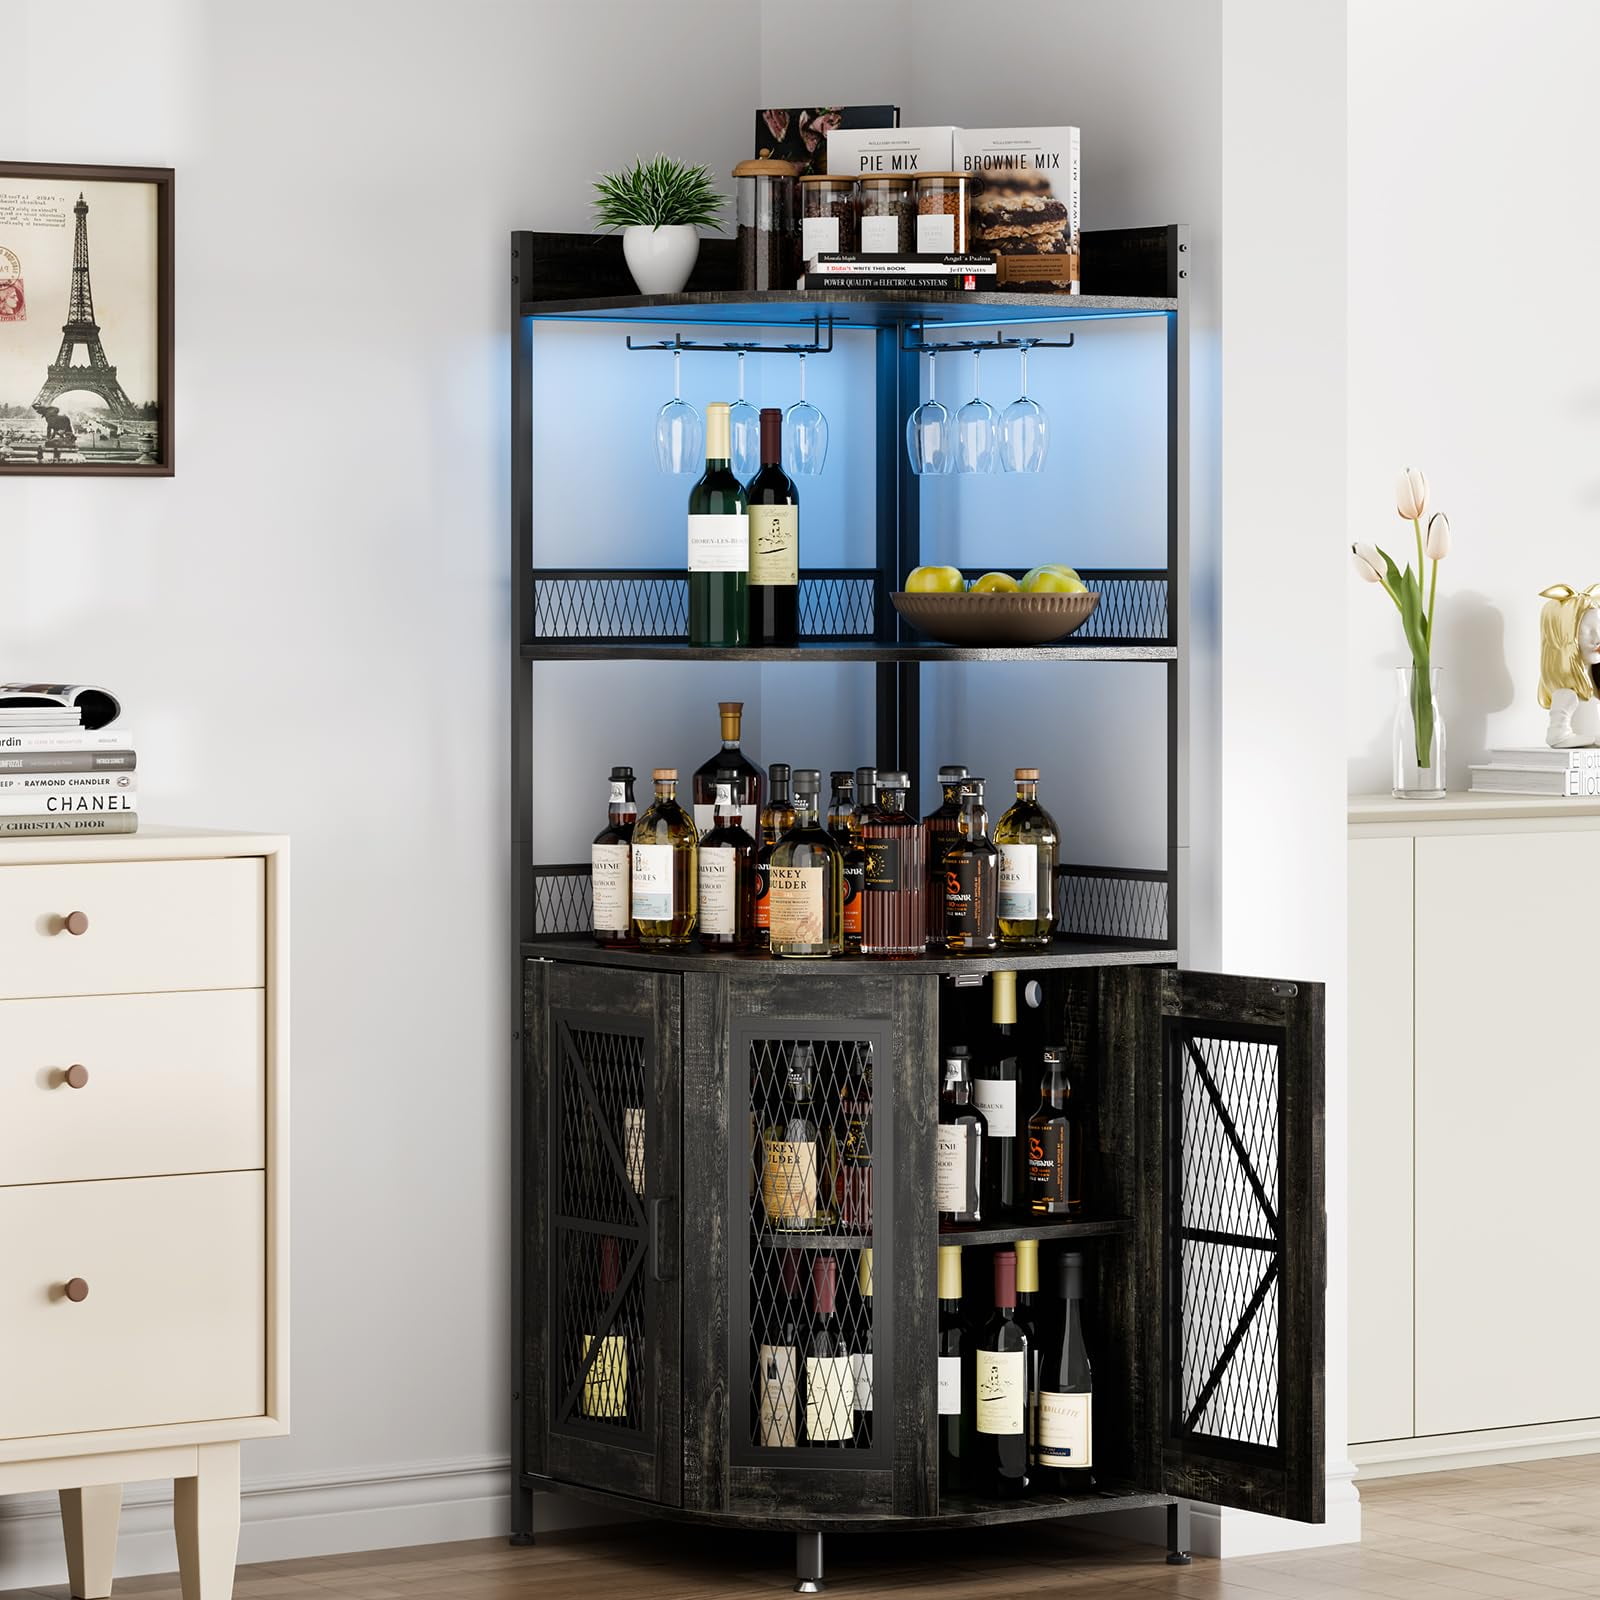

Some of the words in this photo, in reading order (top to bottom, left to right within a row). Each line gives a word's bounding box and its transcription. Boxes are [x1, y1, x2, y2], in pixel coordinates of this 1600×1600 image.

[860, 155, 883, 171] PIE
[892, 154, 918, 170] MIX
[964, 154, 1028, 171] BROWNIE
[1035, 153, 1060, 169] MIX
[824, 278, 845, 287] POWER
[845, 278, 872, 287] QUALITY
[879, 278, 917, 287] ELECTRICAL
[918, 278, 948, 287] SYSTEMS
[24, 779, 66, 787] RAYMOND
[69, 778, 111, 786] CHANDLER
[46, 795, 131, 812] CHANEL
[6, 820, 71, 831] CHRISTIAN
[75, 820, 105, 829] DIOR
